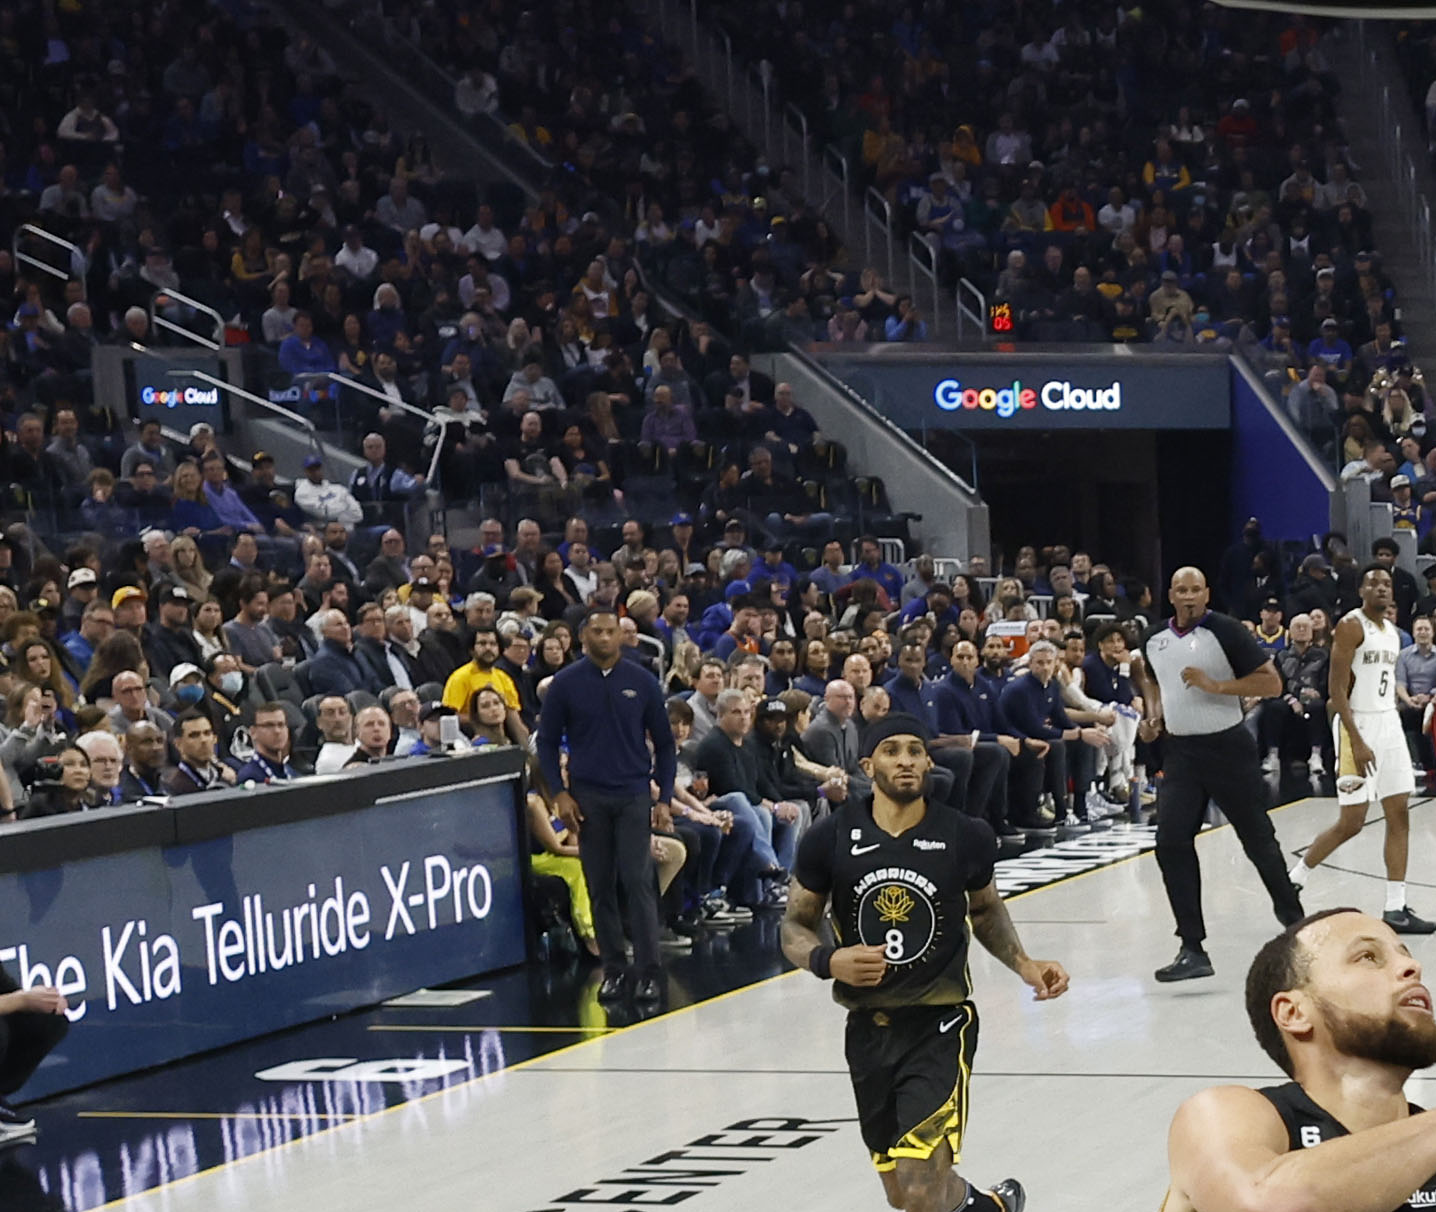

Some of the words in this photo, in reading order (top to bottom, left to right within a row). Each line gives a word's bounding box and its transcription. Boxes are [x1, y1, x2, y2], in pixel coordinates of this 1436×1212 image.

[141, 386, 184, 408] Google
[184, 387, 218, 404] Cloud
[934, 378, 1038, 418] Google
[1041, 381, 1121, 410] Cloud
[1378, 671, 1389, 697] 5
[851, 828, 862, 841] 6
[913, 838, 946, 851] Rakuten
[853, 867, 938, 897] WARRIORS
[0, 944, 87, 1022] he
[101, 919, 182, 1011] Kia
[192, 876, 371, 986] Telluride
[380, 854, 493, 940] X-Pro
[885, 928, 904, 960] 8
[1300, 1125, 1321, 1148] 6
